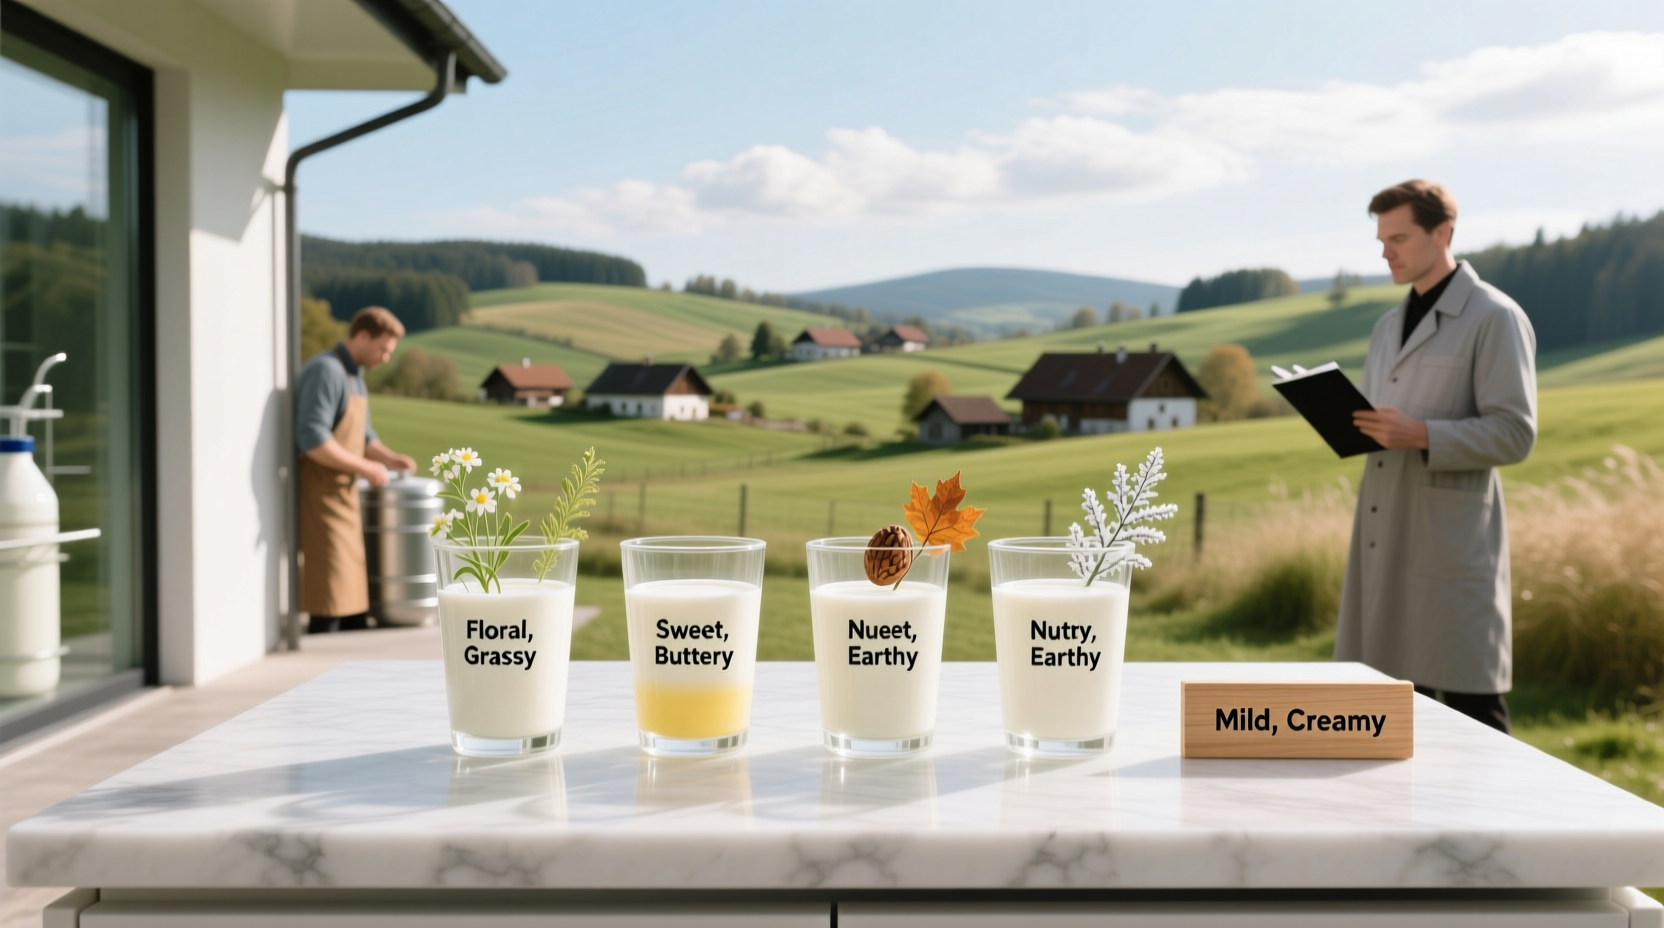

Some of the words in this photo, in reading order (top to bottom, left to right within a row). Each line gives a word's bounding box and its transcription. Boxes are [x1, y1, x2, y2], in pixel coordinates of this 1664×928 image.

[466, 619, 533, 643] Floral,
[656, 618, 729, 643] Sweet,
[848, 619, 917, 643] Nueet,
[1030, 619, 1097, 644] Nutry,
[464, 645, 537, 671] Grassy
[655, 645, 734, 671] Buttery
[848, 645, 919, 672] Earthy
[1031, 645, 1102, 672] Earthy
[1215, 707, 1278, 737] Mild,
[1286, 707, 1387, 738] Creamy
